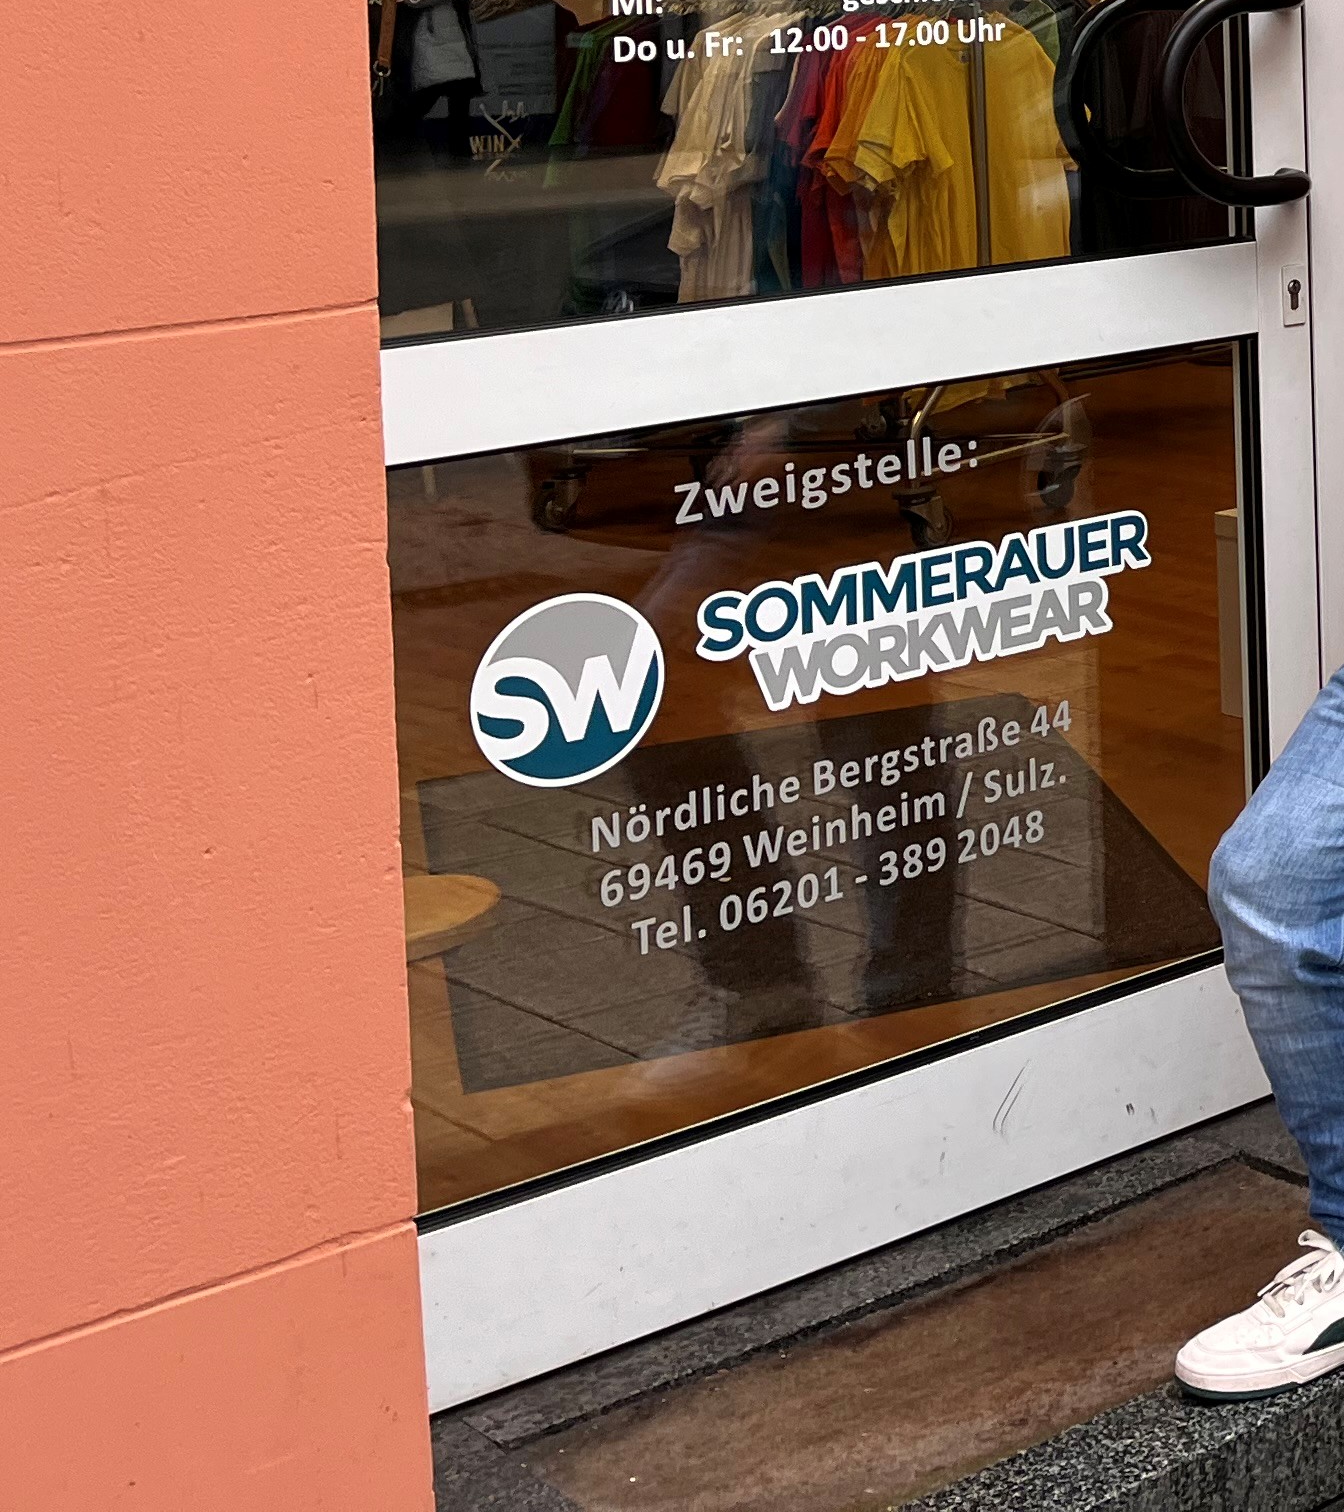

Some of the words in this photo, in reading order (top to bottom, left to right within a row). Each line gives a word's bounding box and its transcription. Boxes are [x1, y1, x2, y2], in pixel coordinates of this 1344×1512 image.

[612, 38, 656, 62] Do
[667, 34, 694, 60] u.
[705, 30, 743, 58] Fr:
[769, 25, 848, 55] 12.00
[874, 21, 951, 50] 17.00
[956, 18, 1006, 45] Uhr
[674, 437, 980, 527] Zweigstelle:
[700, 512, 1148, 655] SOMMERAUER
[756, 580, 1106, 707] WORKWEAR
[470, 623, 657, 762] SW
[590, 772, 803, 854] Nördliche
[813, 719, 1020, 800] Bergstraße
[1029, 699, 1074, 746] 44
[600, 841, 733, 912] 69469
[742, 793, 947, 871] Weinheim
[956, 775, 974, 821] /
[983, 758, 1067, 805] Sulz.
[632, 907, 708, 957] Tel.
[719, 869, 845, 933] 06201
[878, 837, 947, 890] 389
[956, 810, 1046, 866] 2048
